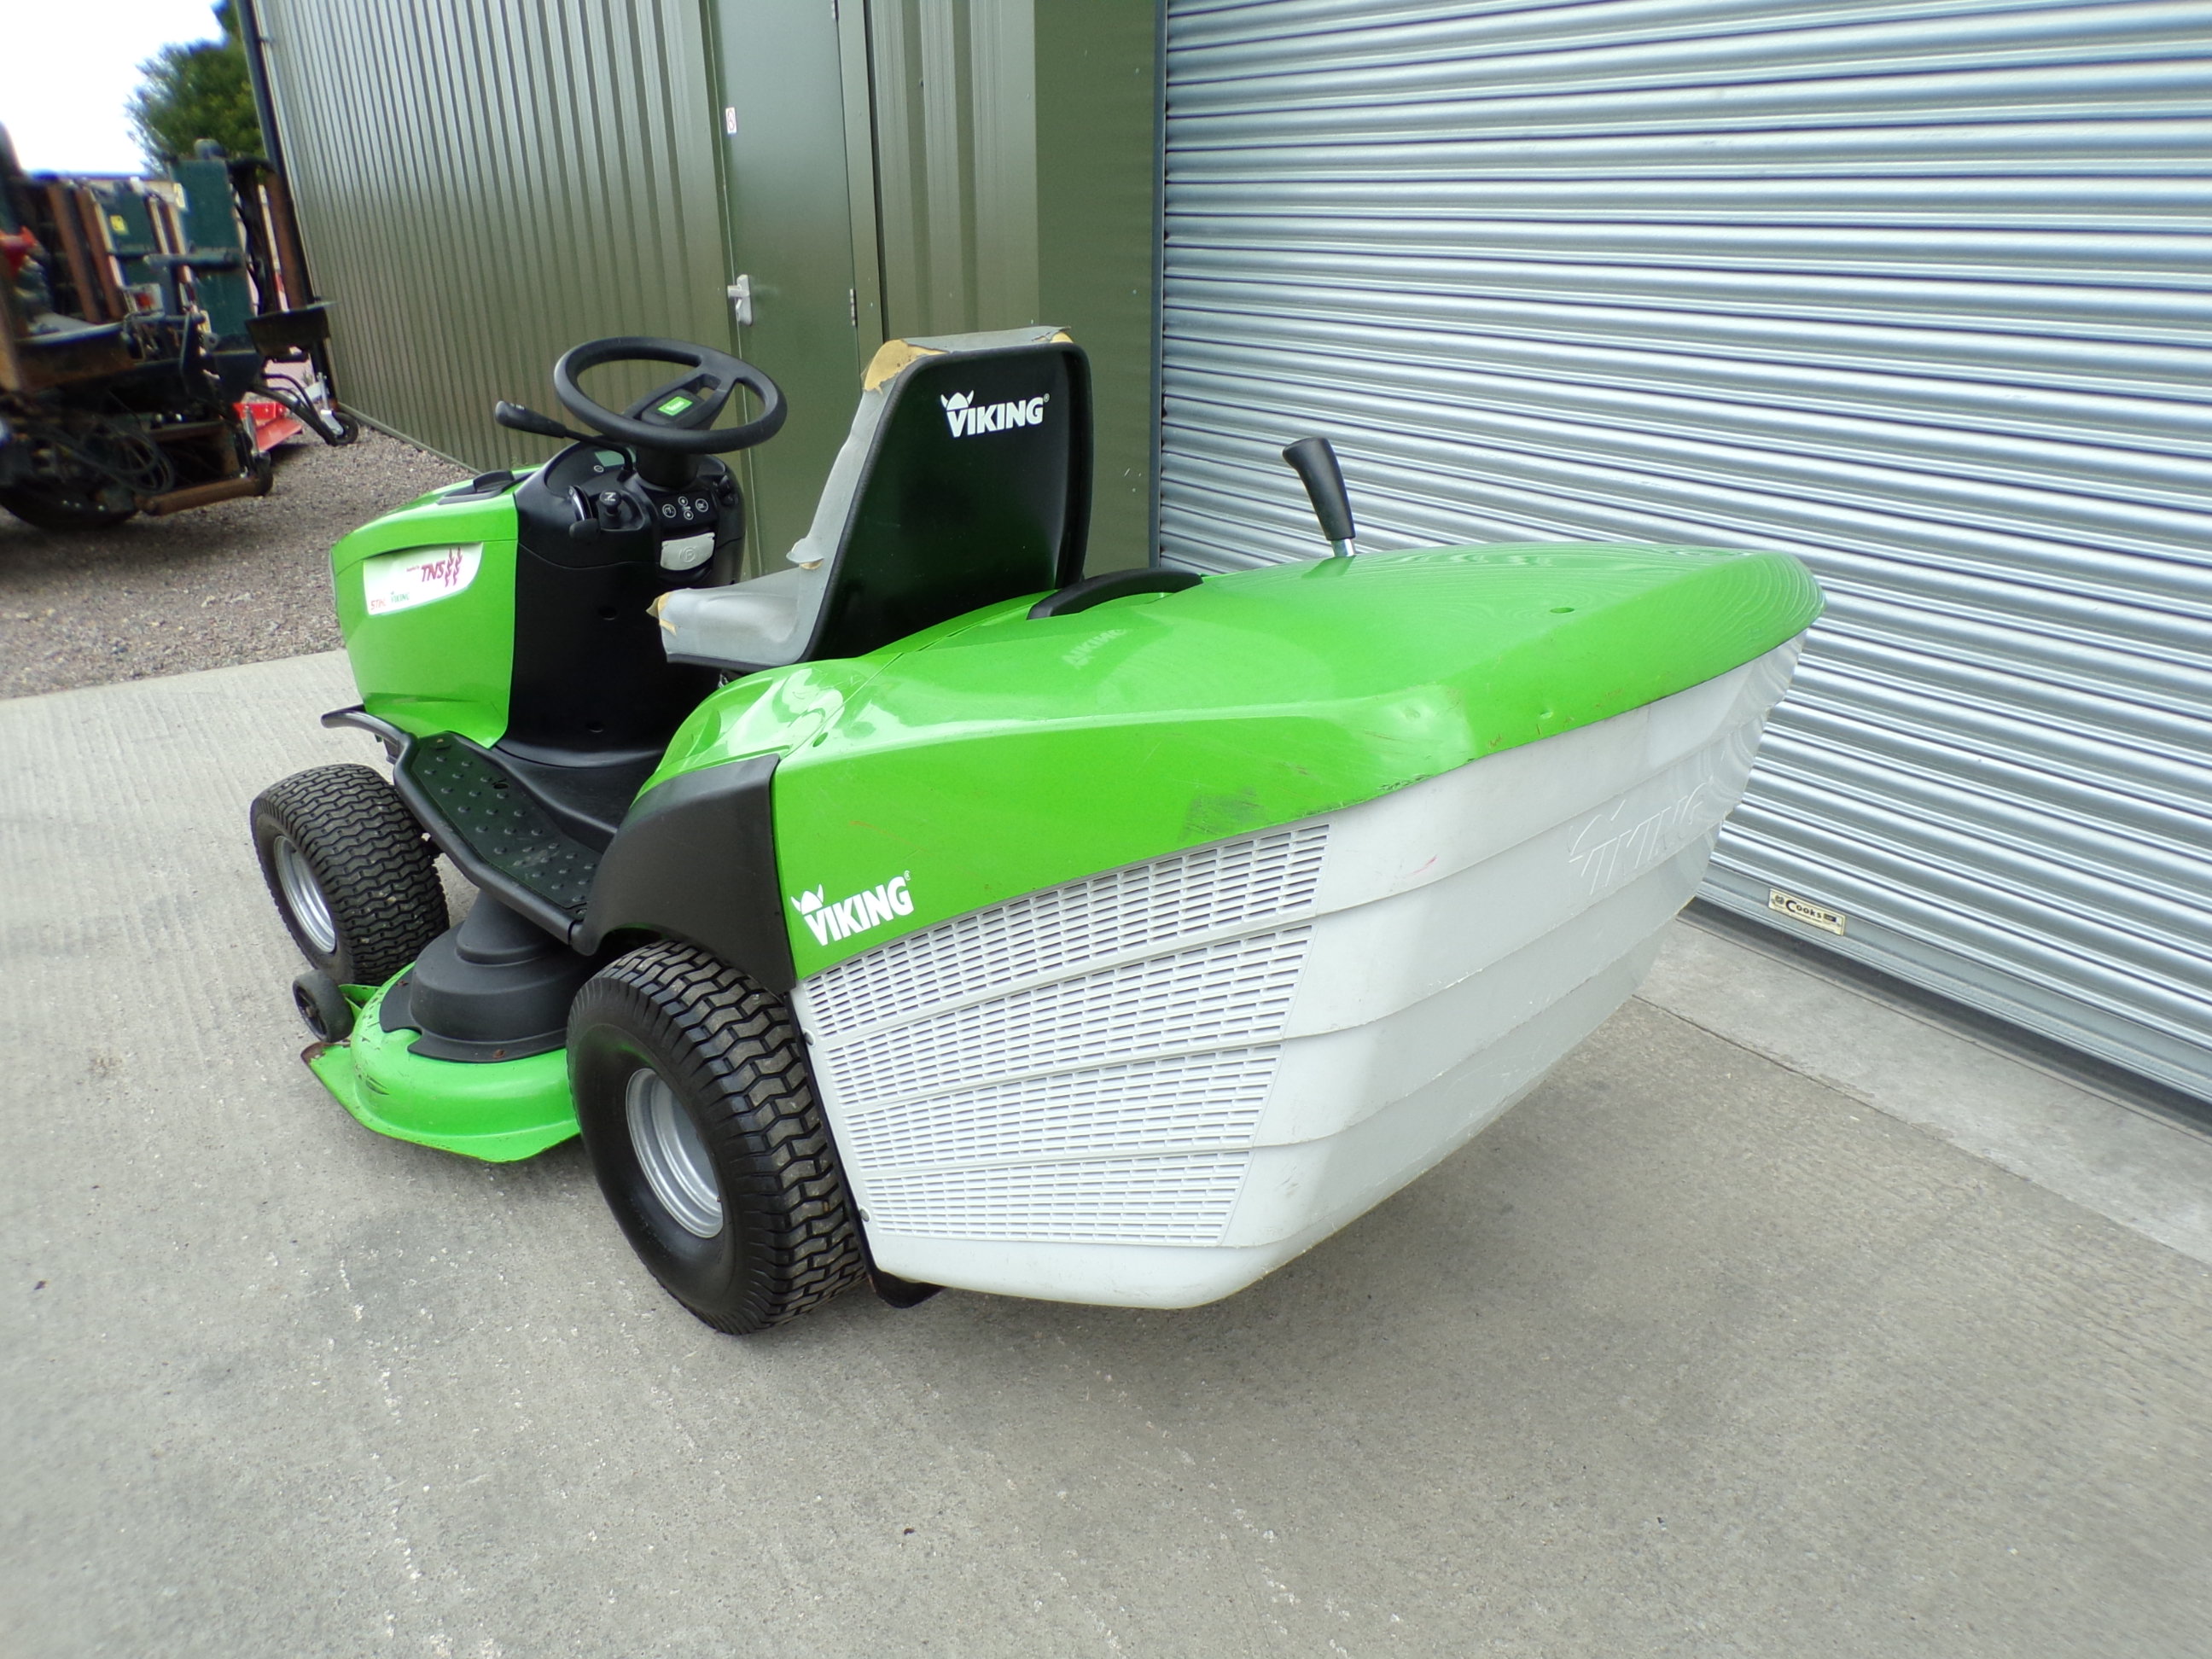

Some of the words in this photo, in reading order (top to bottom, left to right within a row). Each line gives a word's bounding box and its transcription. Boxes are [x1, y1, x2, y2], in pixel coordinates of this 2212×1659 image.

[946, 396, 1044, 438] VIKING
[804, 876, 915, 946] VIKING
[1785, 899, 1822, 919] Cooks
